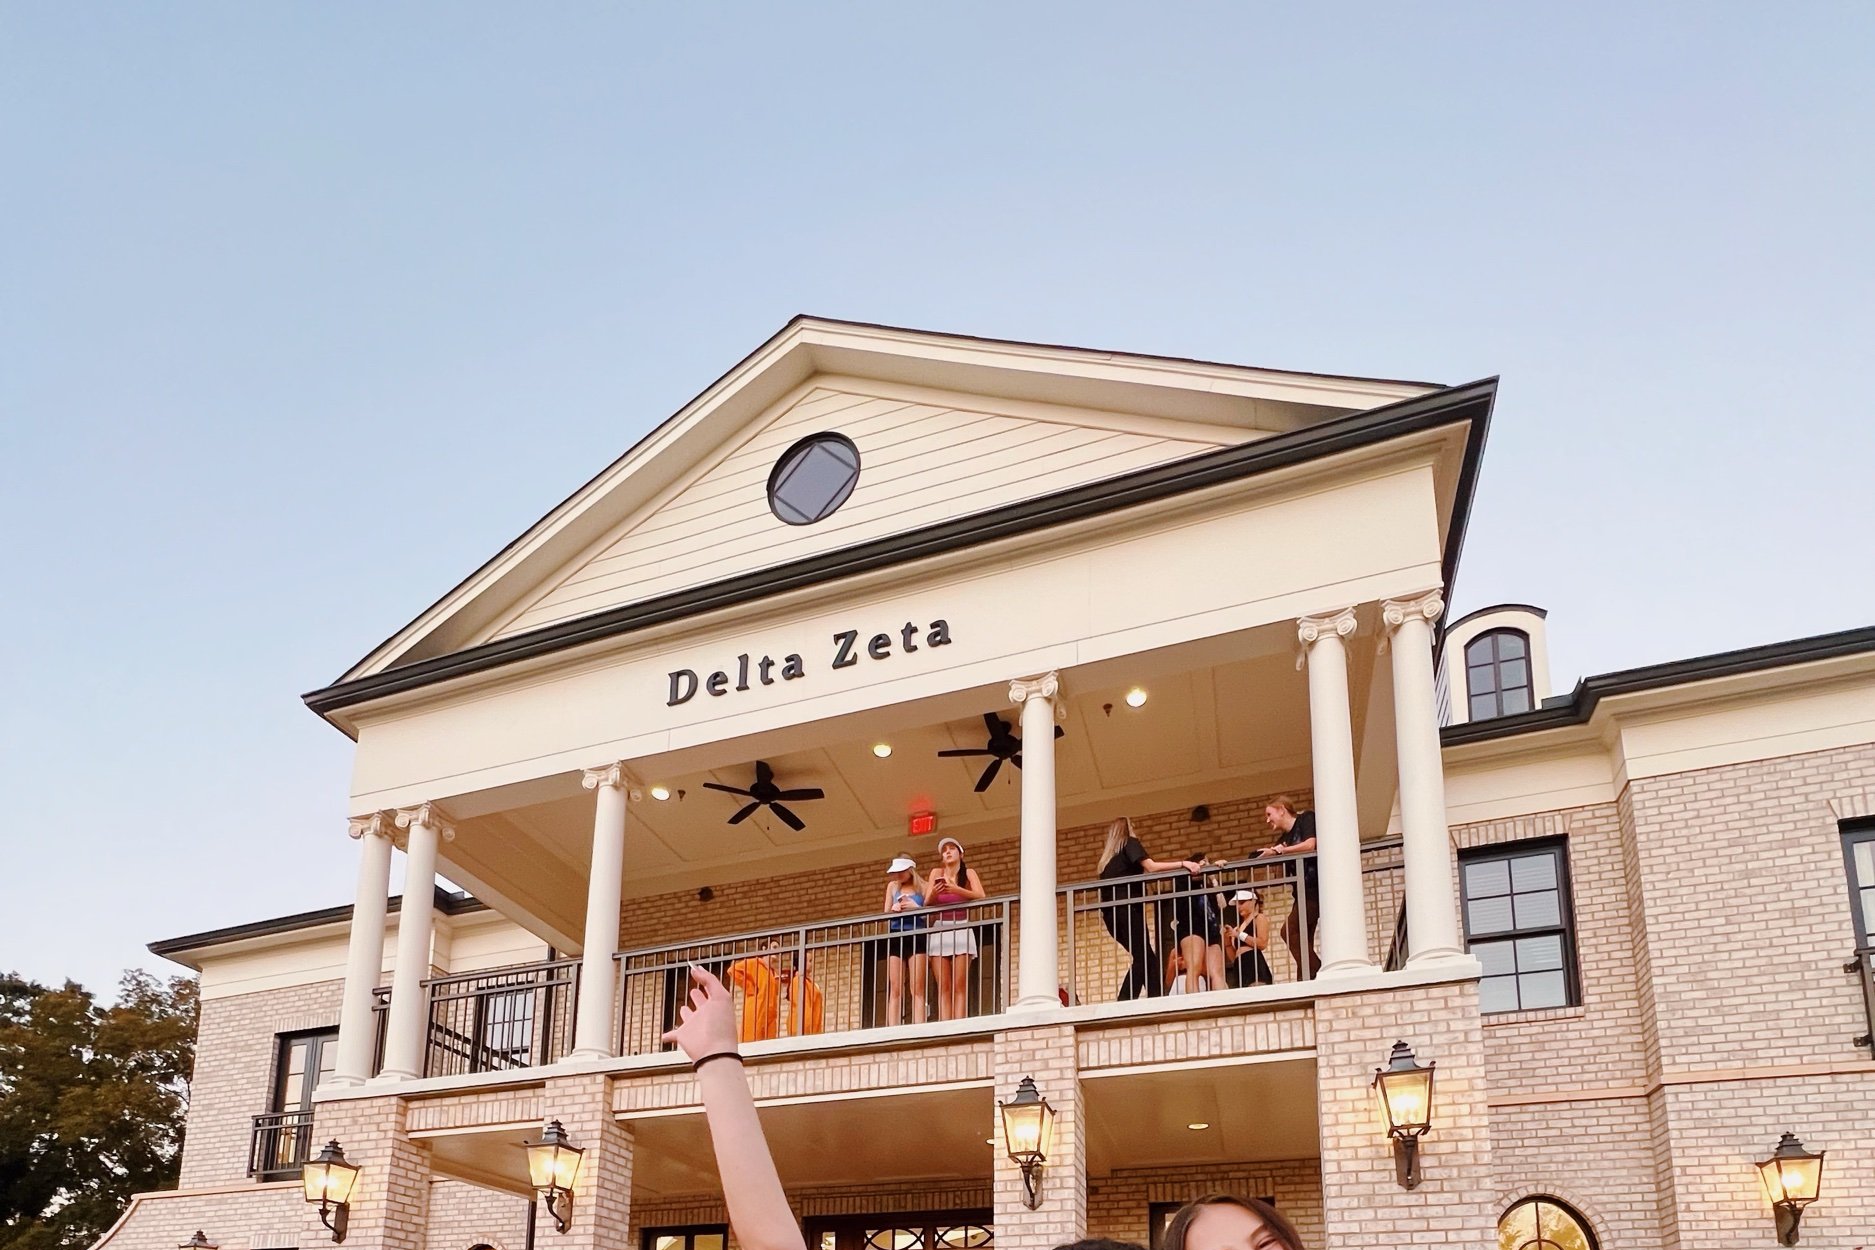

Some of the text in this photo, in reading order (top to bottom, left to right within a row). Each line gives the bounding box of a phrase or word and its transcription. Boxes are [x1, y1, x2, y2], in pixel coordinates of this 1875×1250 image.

[666, 619, 952, 707] Delta Zeta
[912, 816, 933, 833] EXIT
